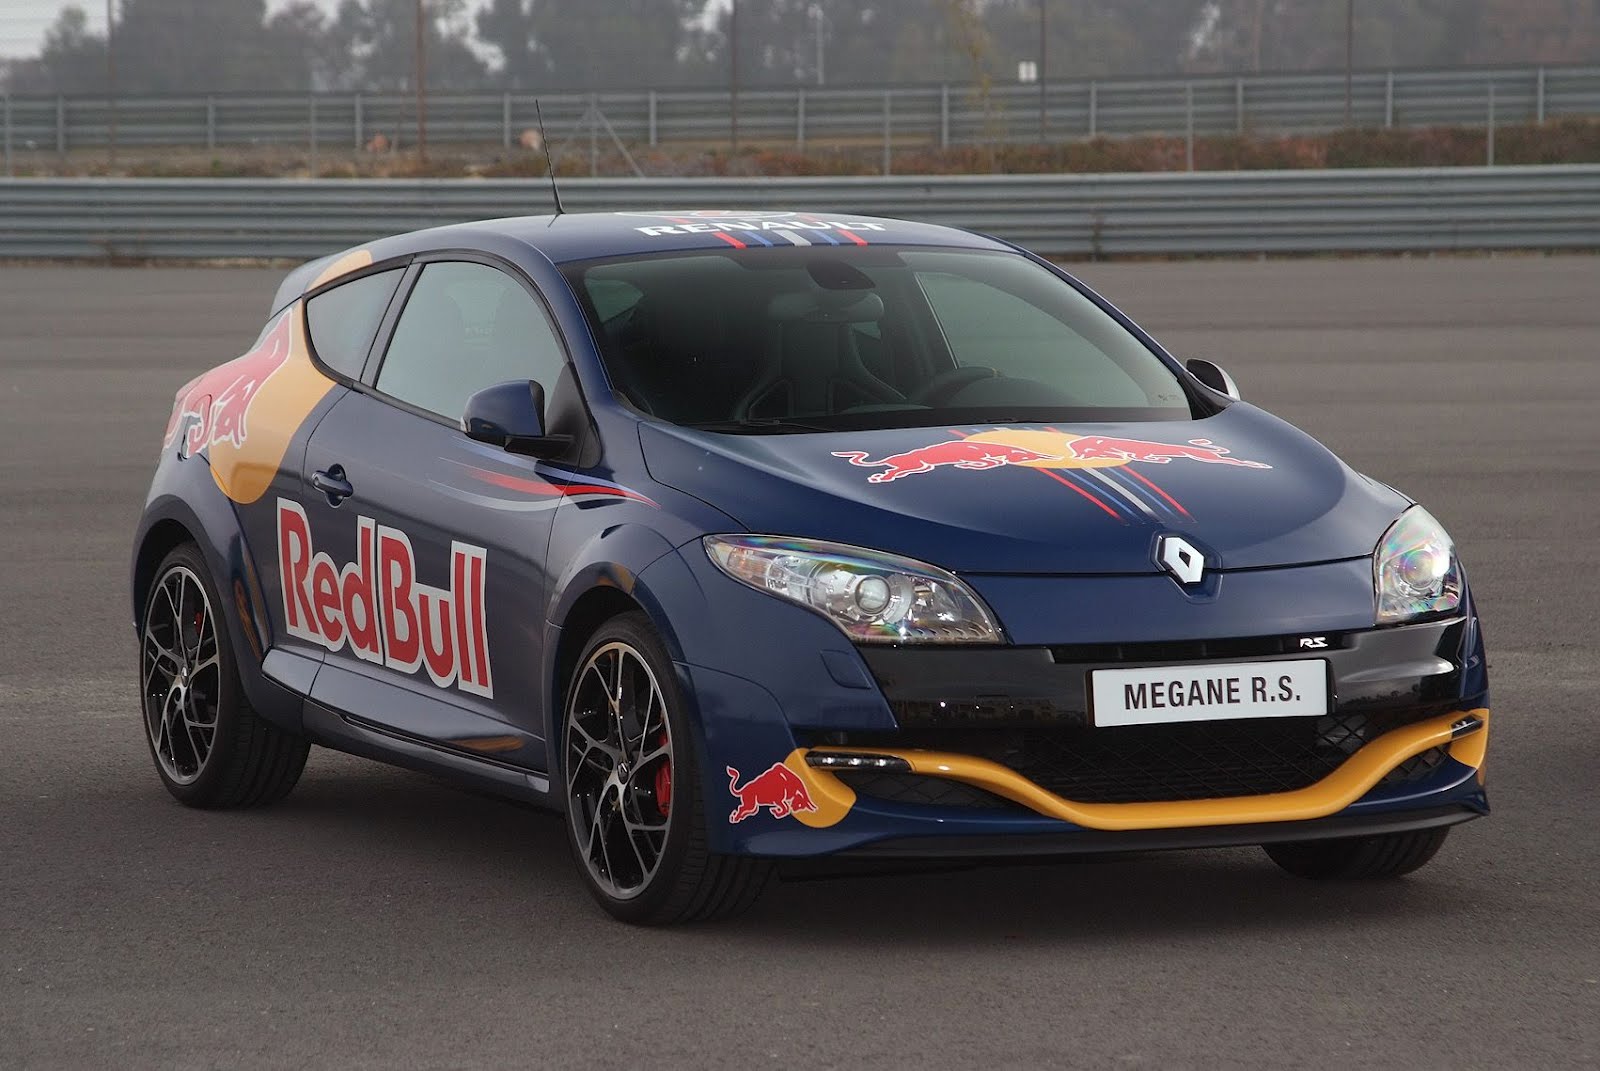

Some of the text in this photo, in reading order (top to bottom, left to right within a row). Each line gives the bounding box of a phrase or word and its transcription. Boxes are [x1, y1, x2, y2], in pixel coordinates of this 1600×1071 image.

[634, 220, 887, 237] RENAULT
[1299, 636, 1329, 649] RS
[1124, 675, 1302, 711] MEGANE R.S.
